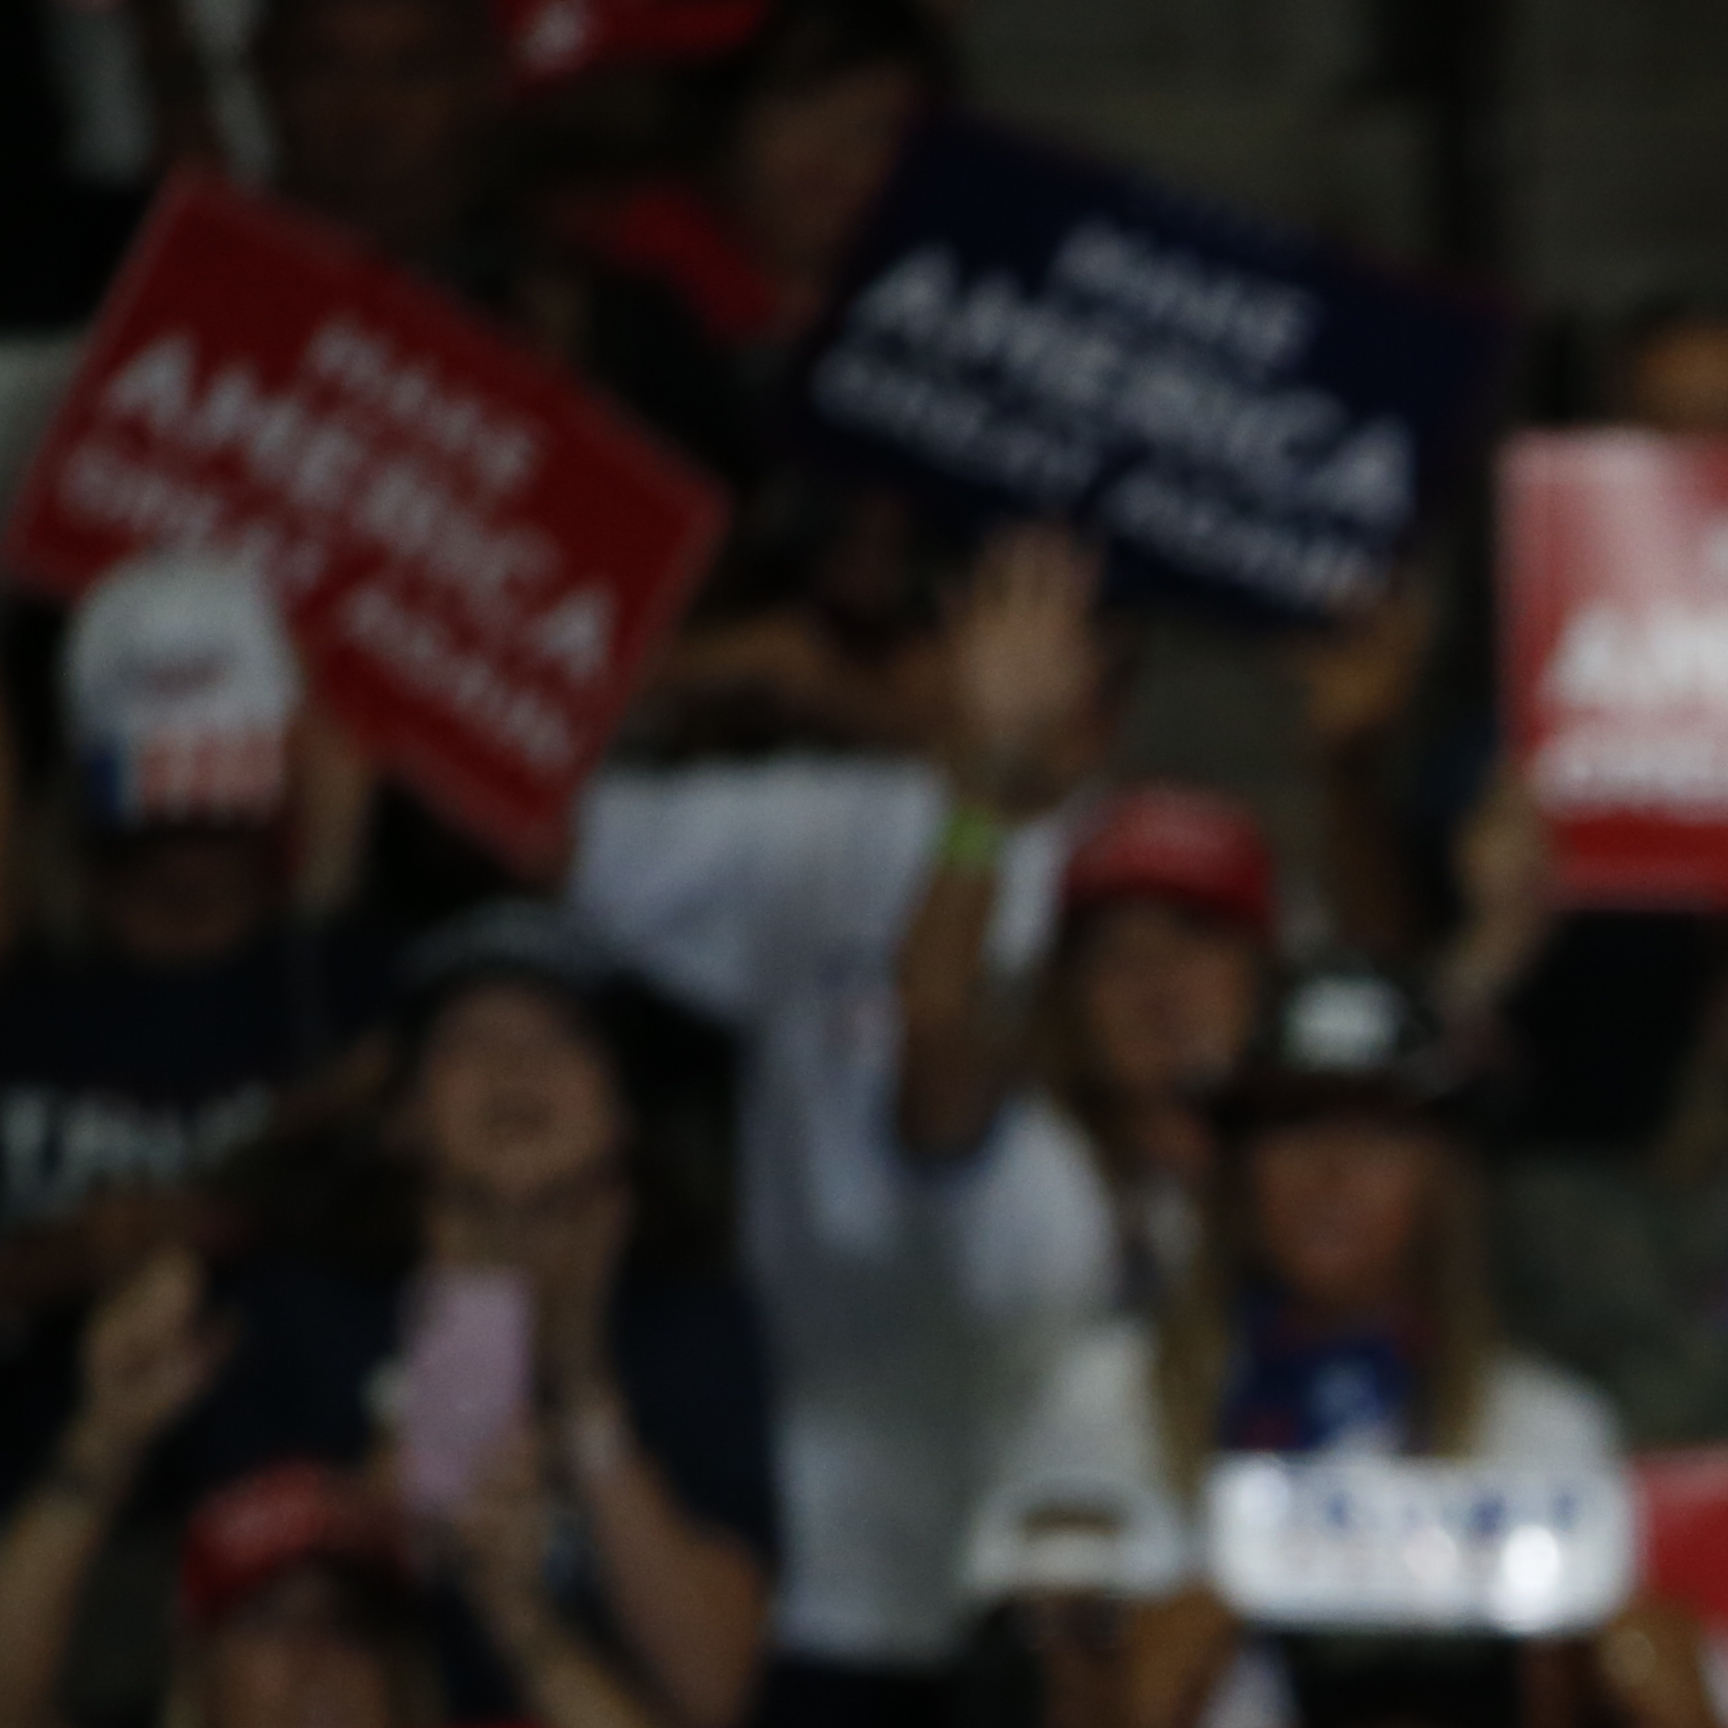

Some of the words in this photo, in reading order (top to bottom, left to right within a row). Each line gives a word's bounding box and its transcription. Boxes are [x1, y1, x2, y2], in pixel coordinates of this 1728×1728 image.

[103, 326, 622, 693] AMERICA
[299, 307, 551, 498] MAKE
[843, 240, 1418, 527] AMERICA
